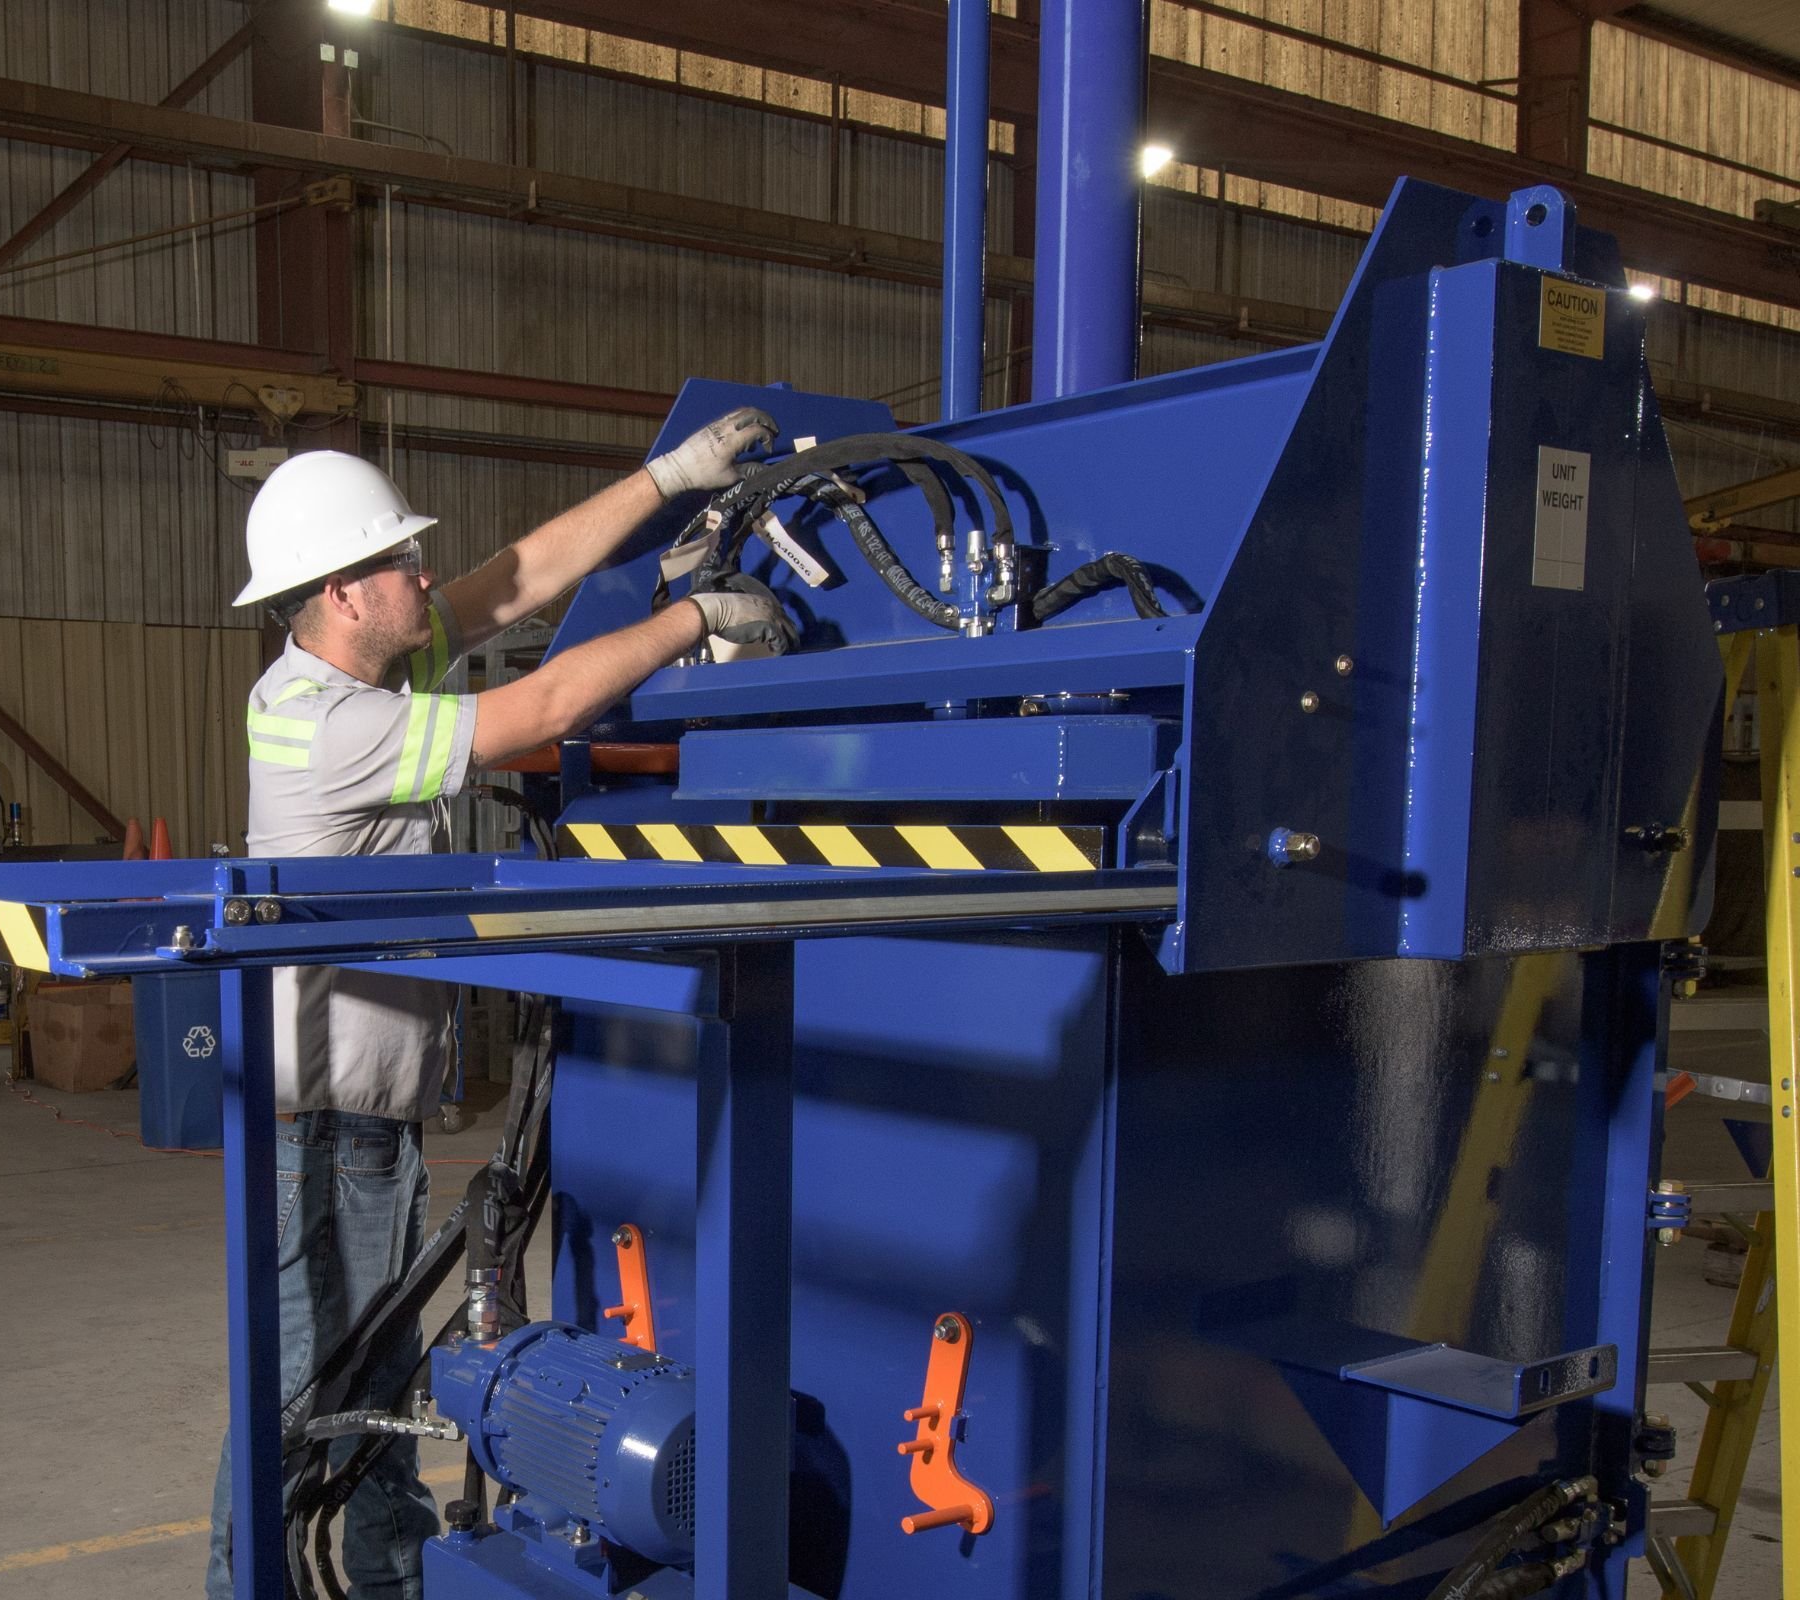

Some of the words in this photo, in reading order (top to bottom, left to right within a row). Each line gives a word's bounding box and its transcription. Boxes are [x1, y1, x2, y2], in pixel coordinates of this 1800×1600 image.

[1547, 289, 1599, 316] CAUTION
[1552, 463, 1577, 481] UNIT
[1542, 489, 1584, 511] WEIGHT
[858, 521, 871, 536] RS
